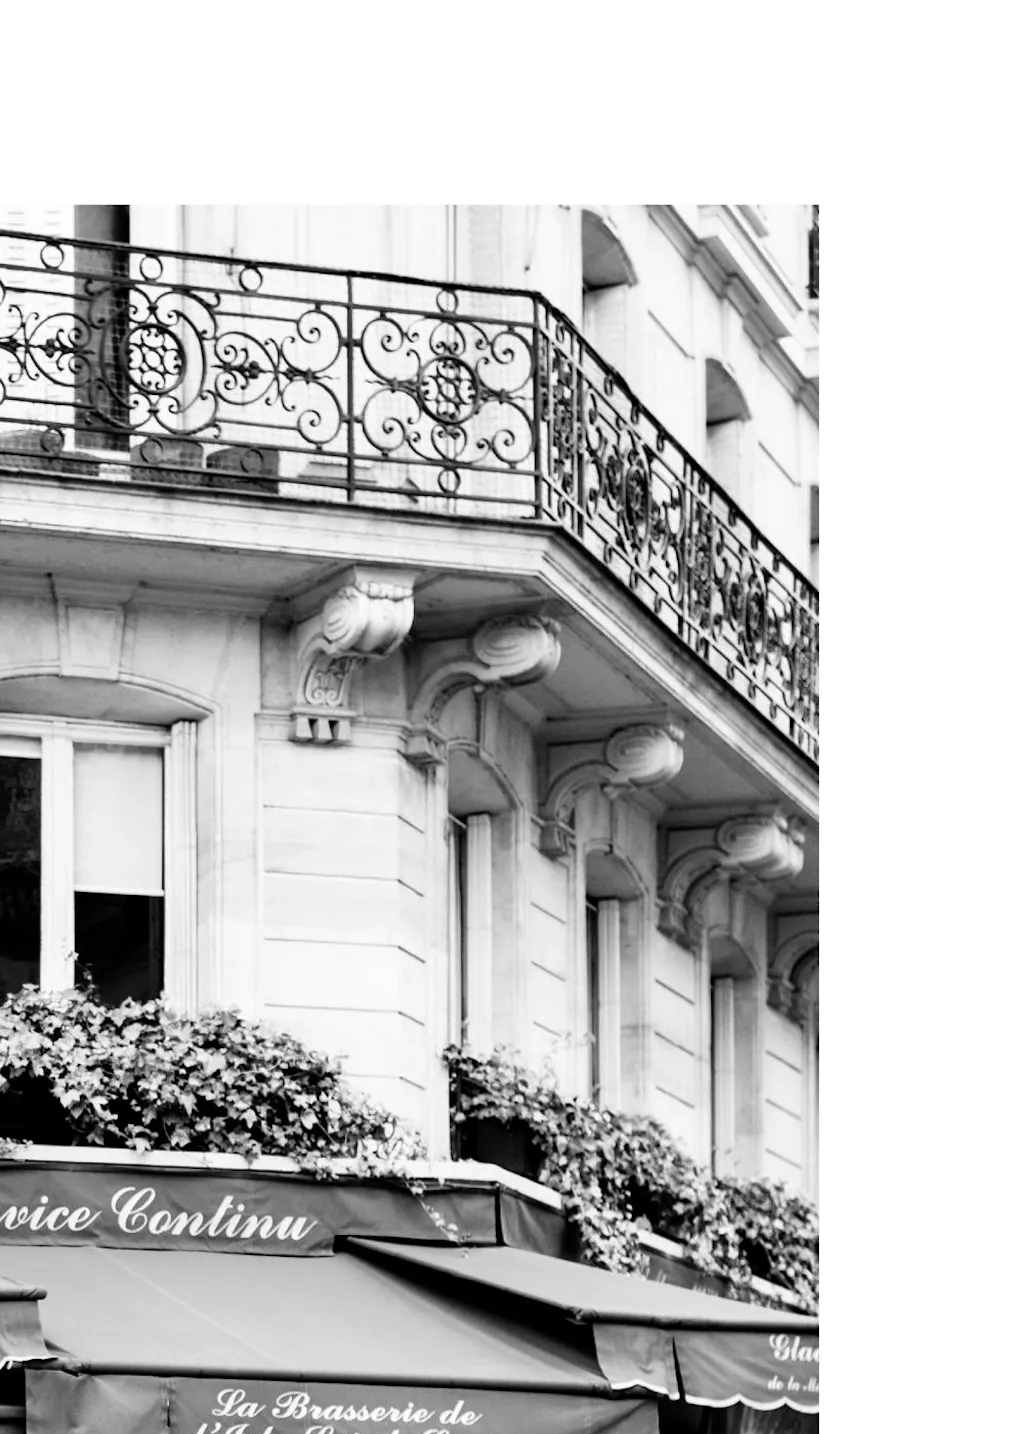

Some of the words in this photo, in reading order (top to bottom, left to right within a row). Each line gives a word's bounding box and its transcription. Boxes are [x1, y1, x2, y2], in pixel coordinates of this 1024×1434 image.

[111, 1186, 318, 1241] Continu
[212, 1388, 266, 1418] La
[272, 1391, 435, 1424] Brasserie
[439, 1400, 484, 1425] de
